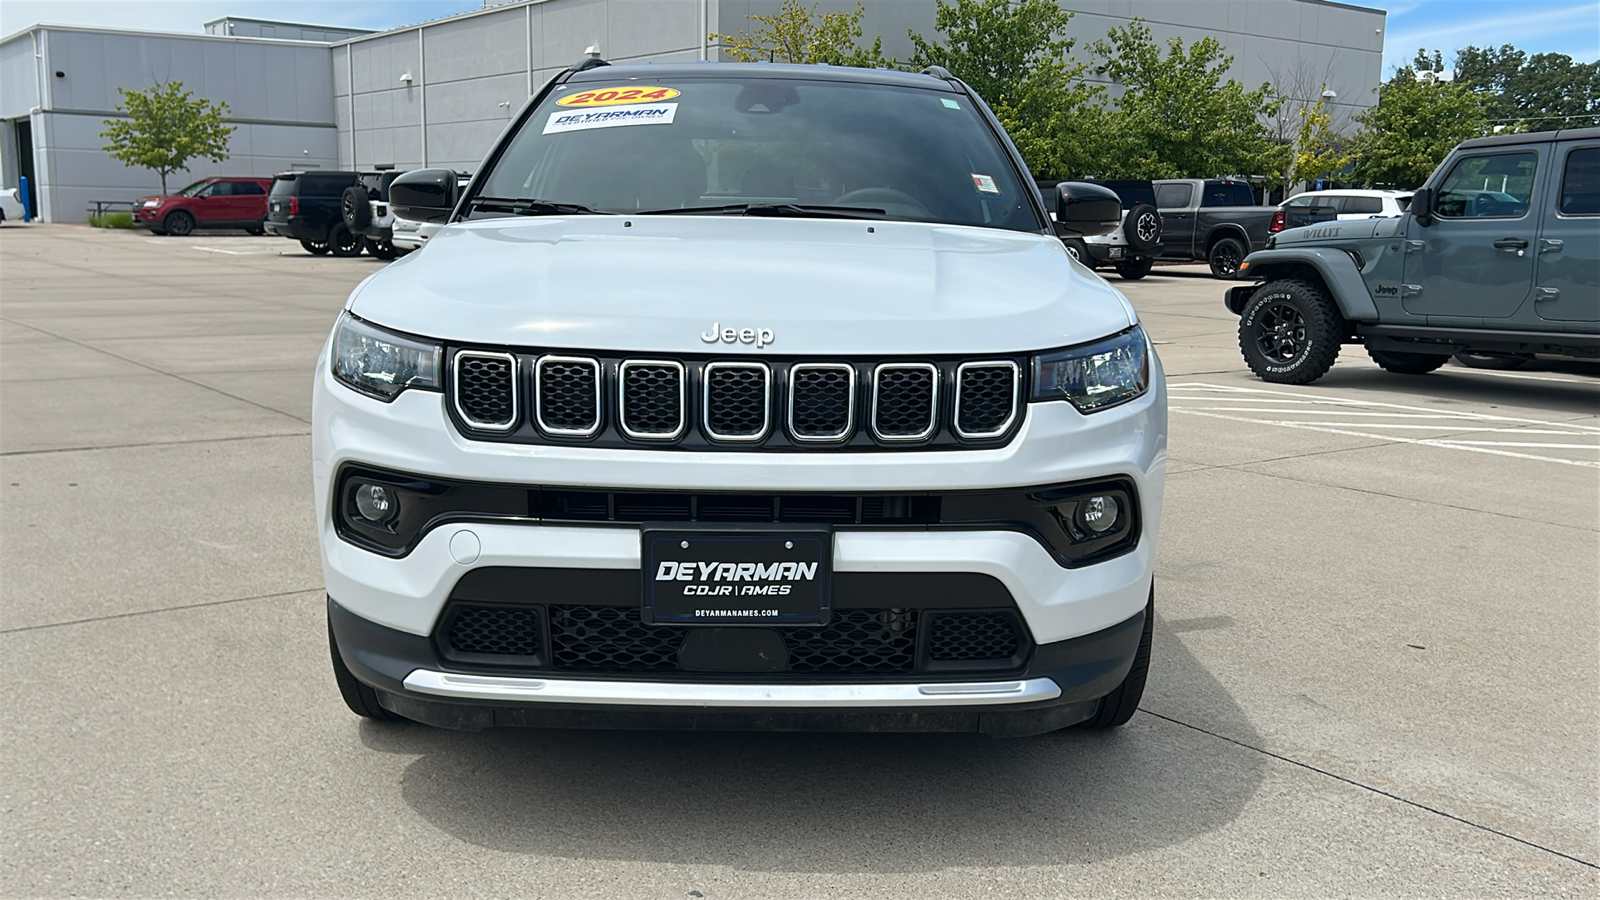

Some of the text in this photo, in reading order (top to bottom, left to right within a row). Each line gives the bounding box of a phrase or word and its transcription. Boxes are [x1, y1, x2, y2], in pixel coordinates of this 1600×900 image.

[567, 89, 669, 105] 2024
[555, 108, 669, 124] DEYARMAN
[562, 117, 608, 126] CERTIFIED
[1303, 227, 1341, 239] WILLYS
[1375, 284, 1398, 296] Jeep
[701, 322, 775, 349] Jeep
[655, 561, 818, 582] DEYARMAN
[683, 585, 792, 596] CDJR AMES
[695, 609, 779, 617] DEYARMANAMES.COM
